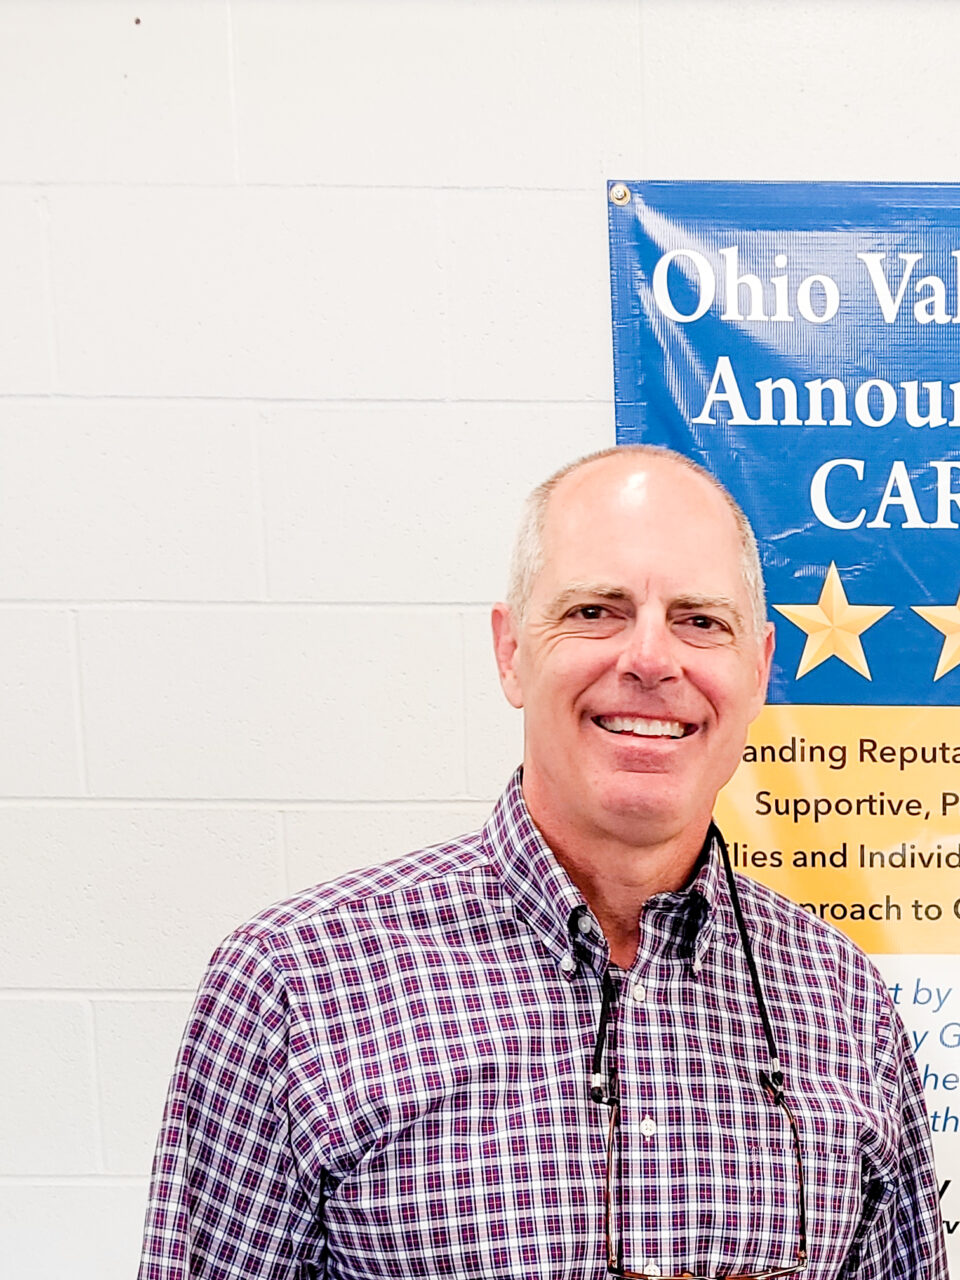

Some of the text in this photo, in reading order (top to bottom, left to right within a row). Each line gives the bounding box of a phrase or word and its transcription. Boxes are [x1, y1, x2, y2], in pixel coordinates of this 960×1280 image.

[651, 246, 841, 324] Ohio
[742, 737, 847, 769] anding
[756, 791, 930, 823] Supportive,
[727, 843, 782, 868] lies
[793, 843, 847, 868] and
[912, 900, 942, 920] to
[913, 978, 952, 1013] by
